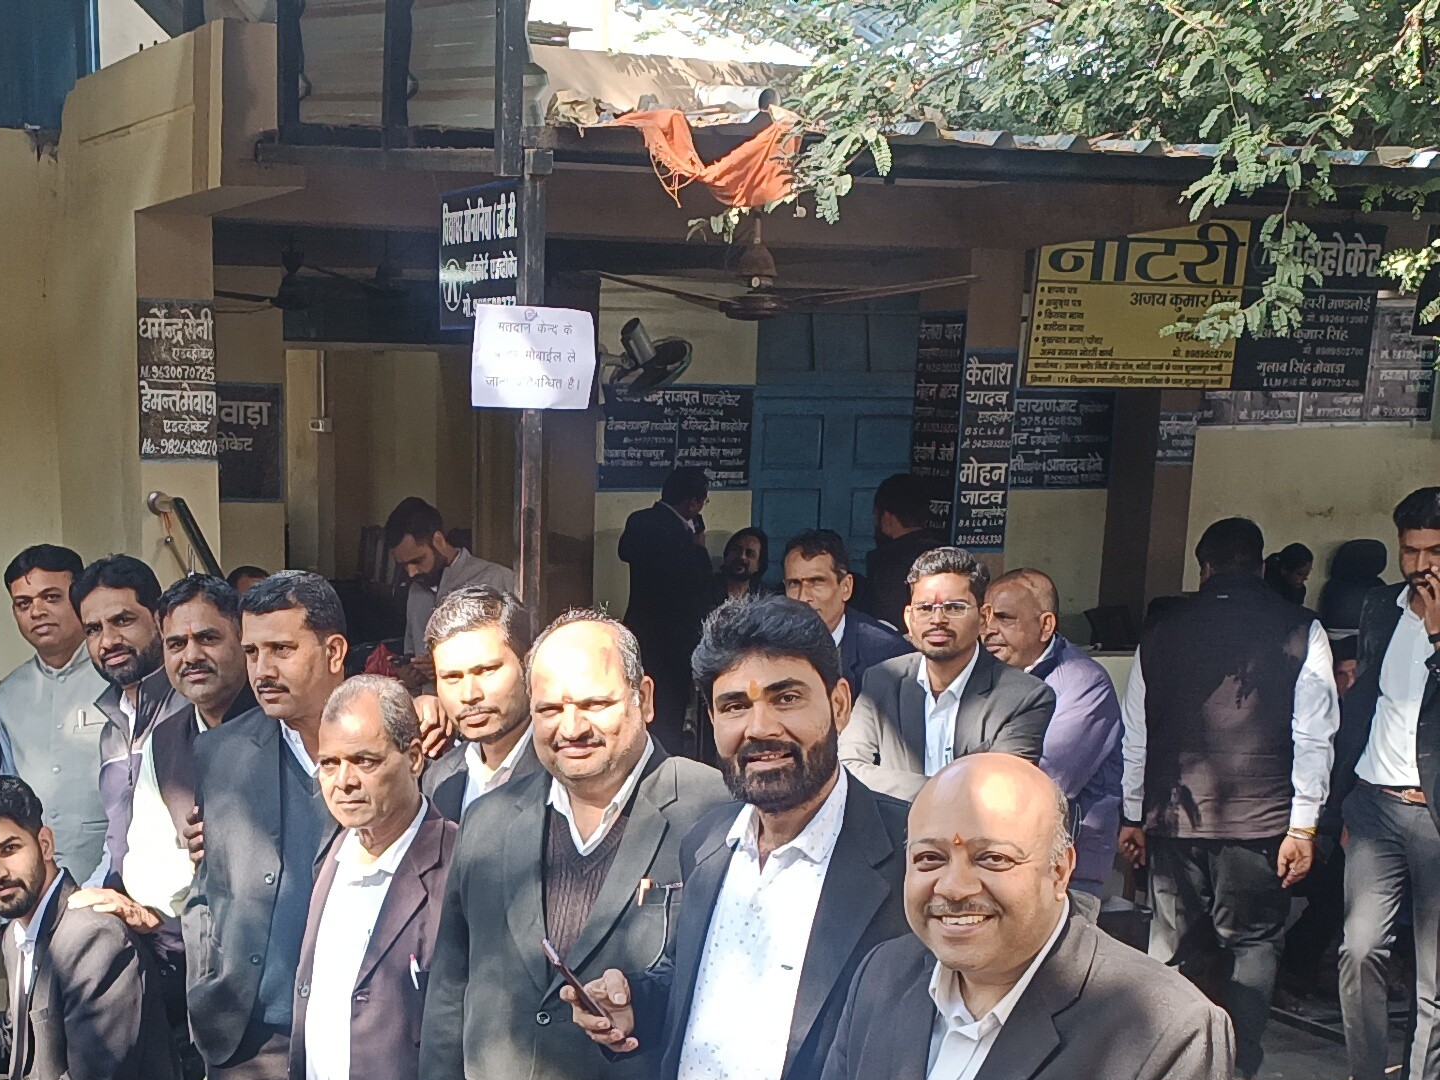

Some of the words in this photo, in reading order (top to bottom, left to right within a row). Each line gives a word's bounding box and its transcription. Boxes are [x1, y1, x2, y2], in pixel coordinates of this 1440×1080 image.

[1130, 291, 1167, 307] अजय
[1169, 292, 1210, 313] कुमार
[498, 321, 531, 334] मतदान
[563, 323, 573, 336] के
[965, 391, 1010, 407] यादव
[959, 456, 1009, 487] मोहन
[960, 490, 1006, 505] जाटव
